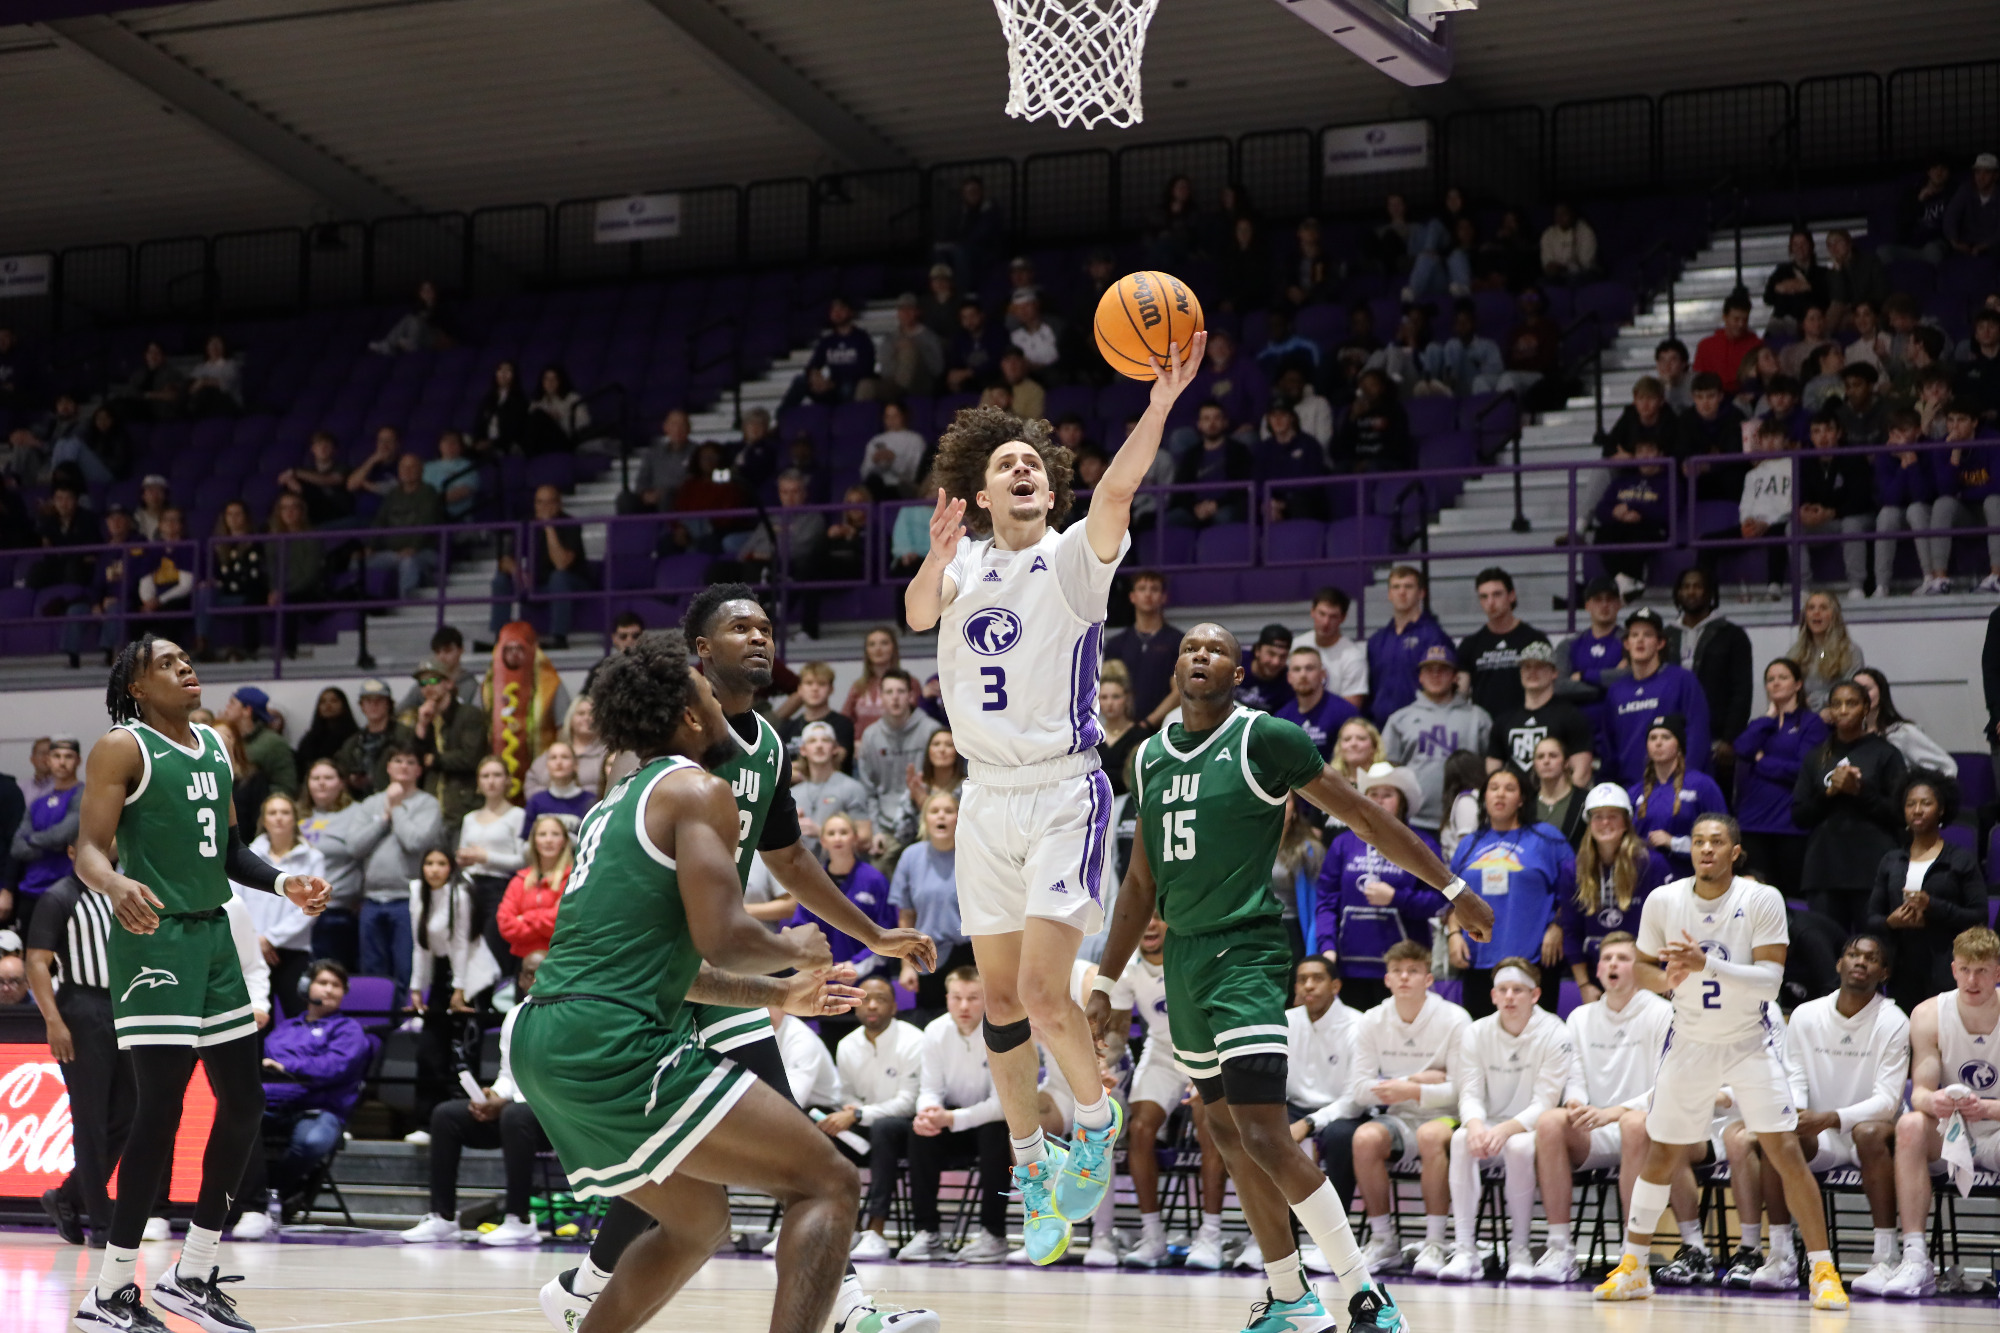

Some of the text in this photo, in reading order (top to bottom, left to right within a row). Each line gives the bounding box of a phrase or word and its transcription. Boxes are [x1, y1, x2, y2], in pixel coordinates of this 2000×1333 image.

[980, 666, 1008, 711] 3
[1618, 698, 1659, 716] LIONS
[186, 772, 219, 801] JU
[732, 767, 761, 803] JU
[1161, 772, 1202, 805] JU
[196, 807, 218, 858] 3
[1162, 808, 1197, 862] 15
[1702, 980, 1722, 1010] 2
